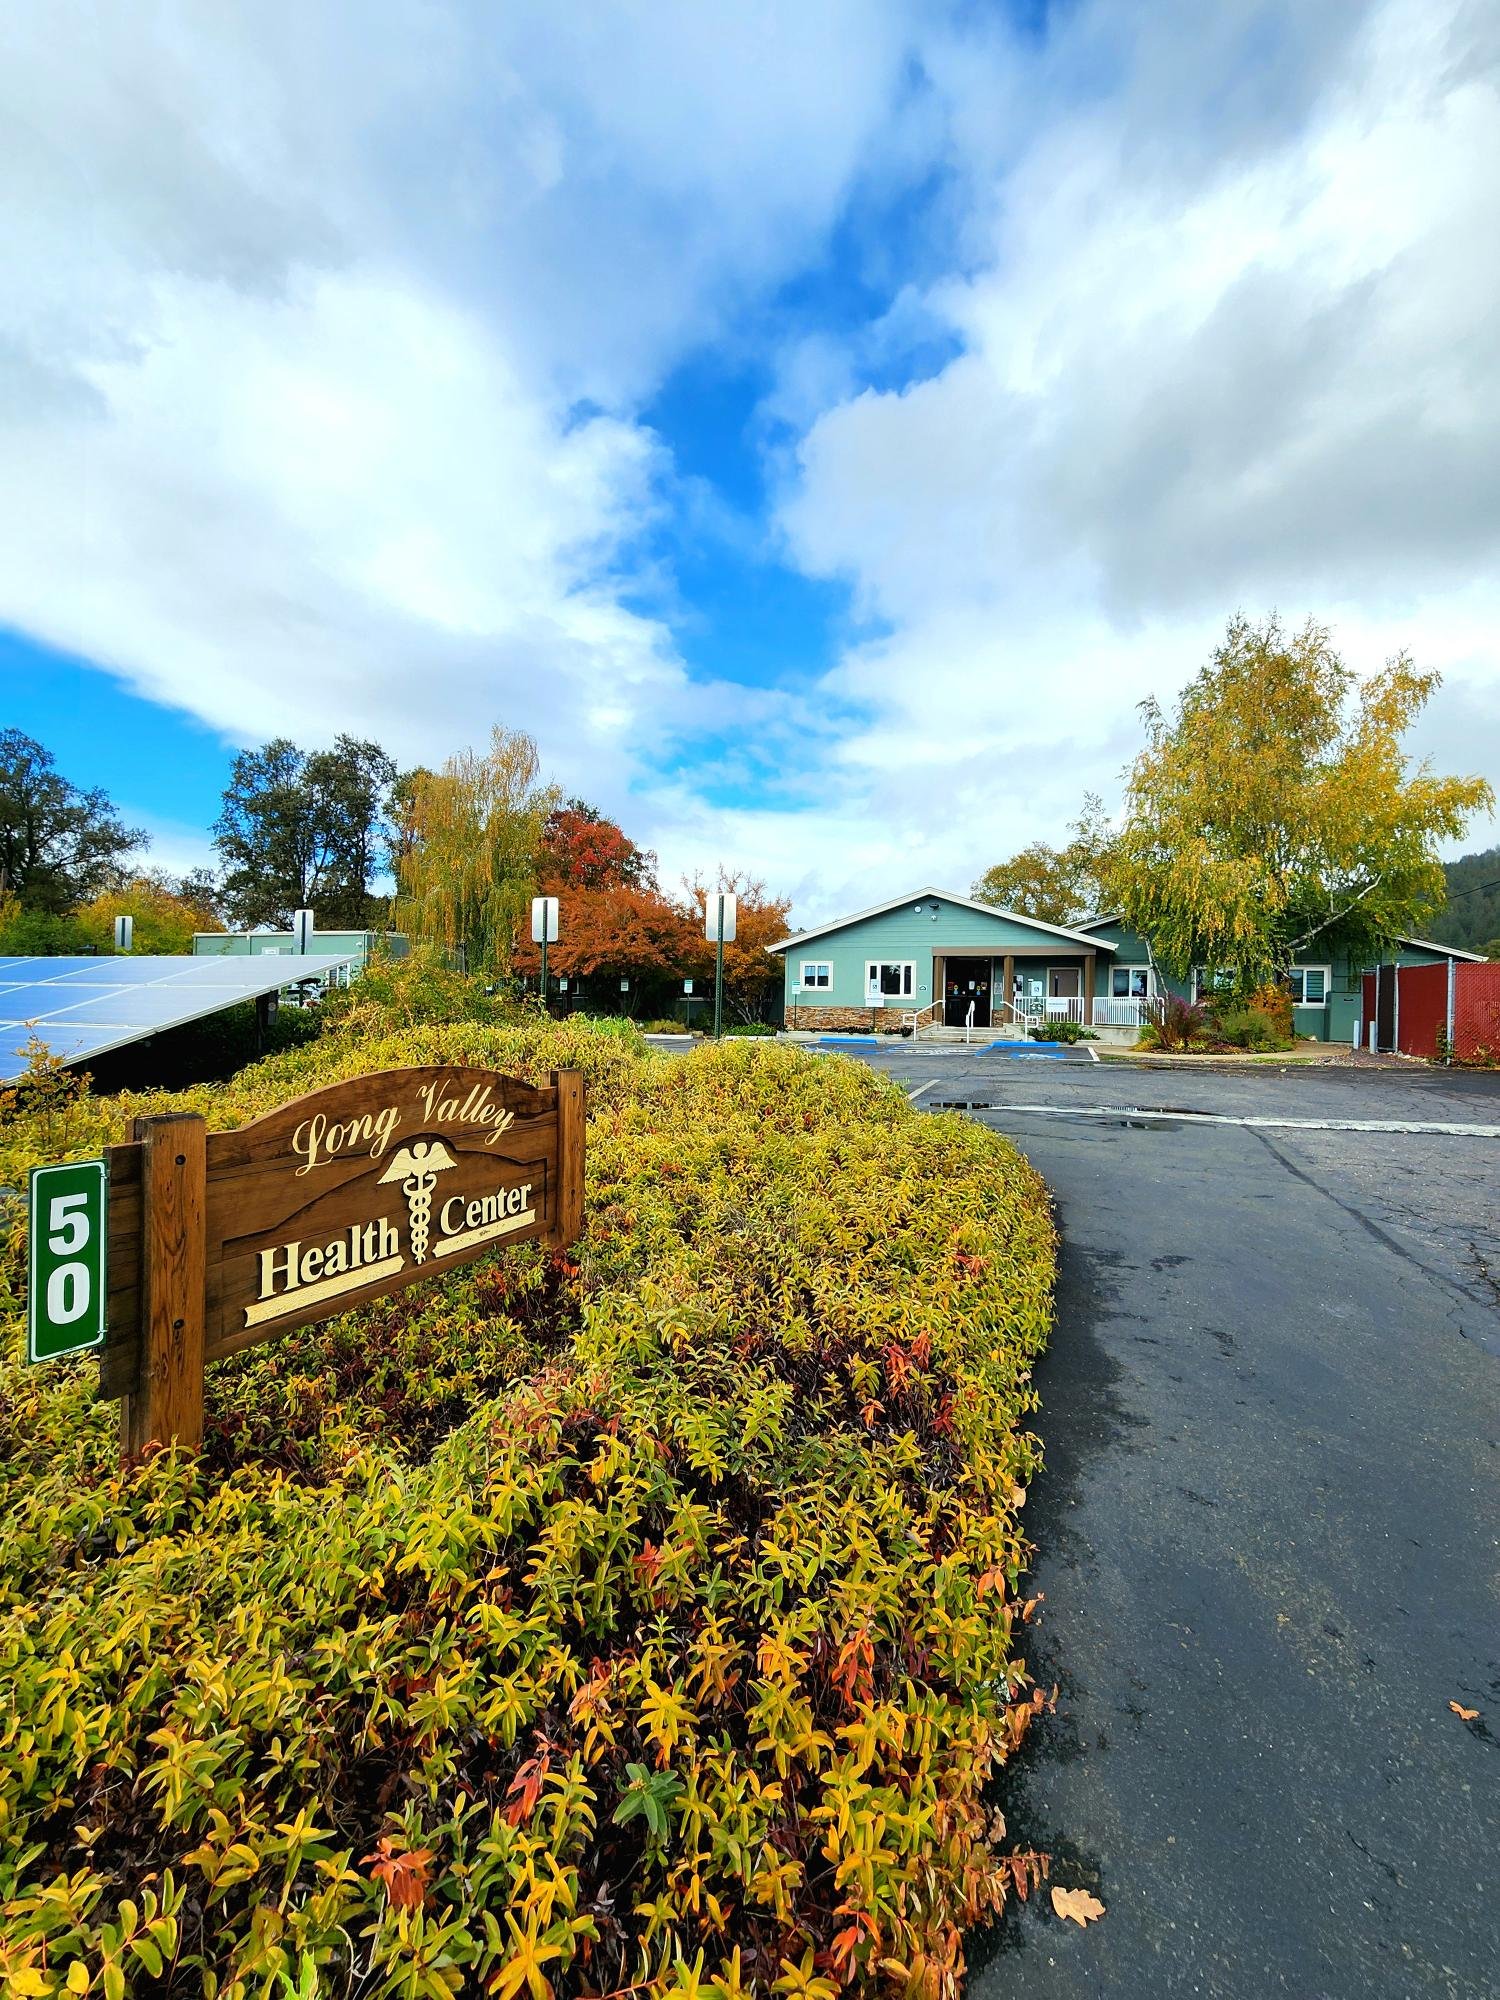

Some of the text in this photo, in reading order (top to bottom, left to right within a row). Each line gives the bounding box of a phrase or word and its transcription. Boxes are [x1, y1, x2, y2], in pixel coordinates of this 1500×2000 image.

[292, 1079, 515, 1177] Long Valley
[258, 1183, 532, 1300] Health Center
